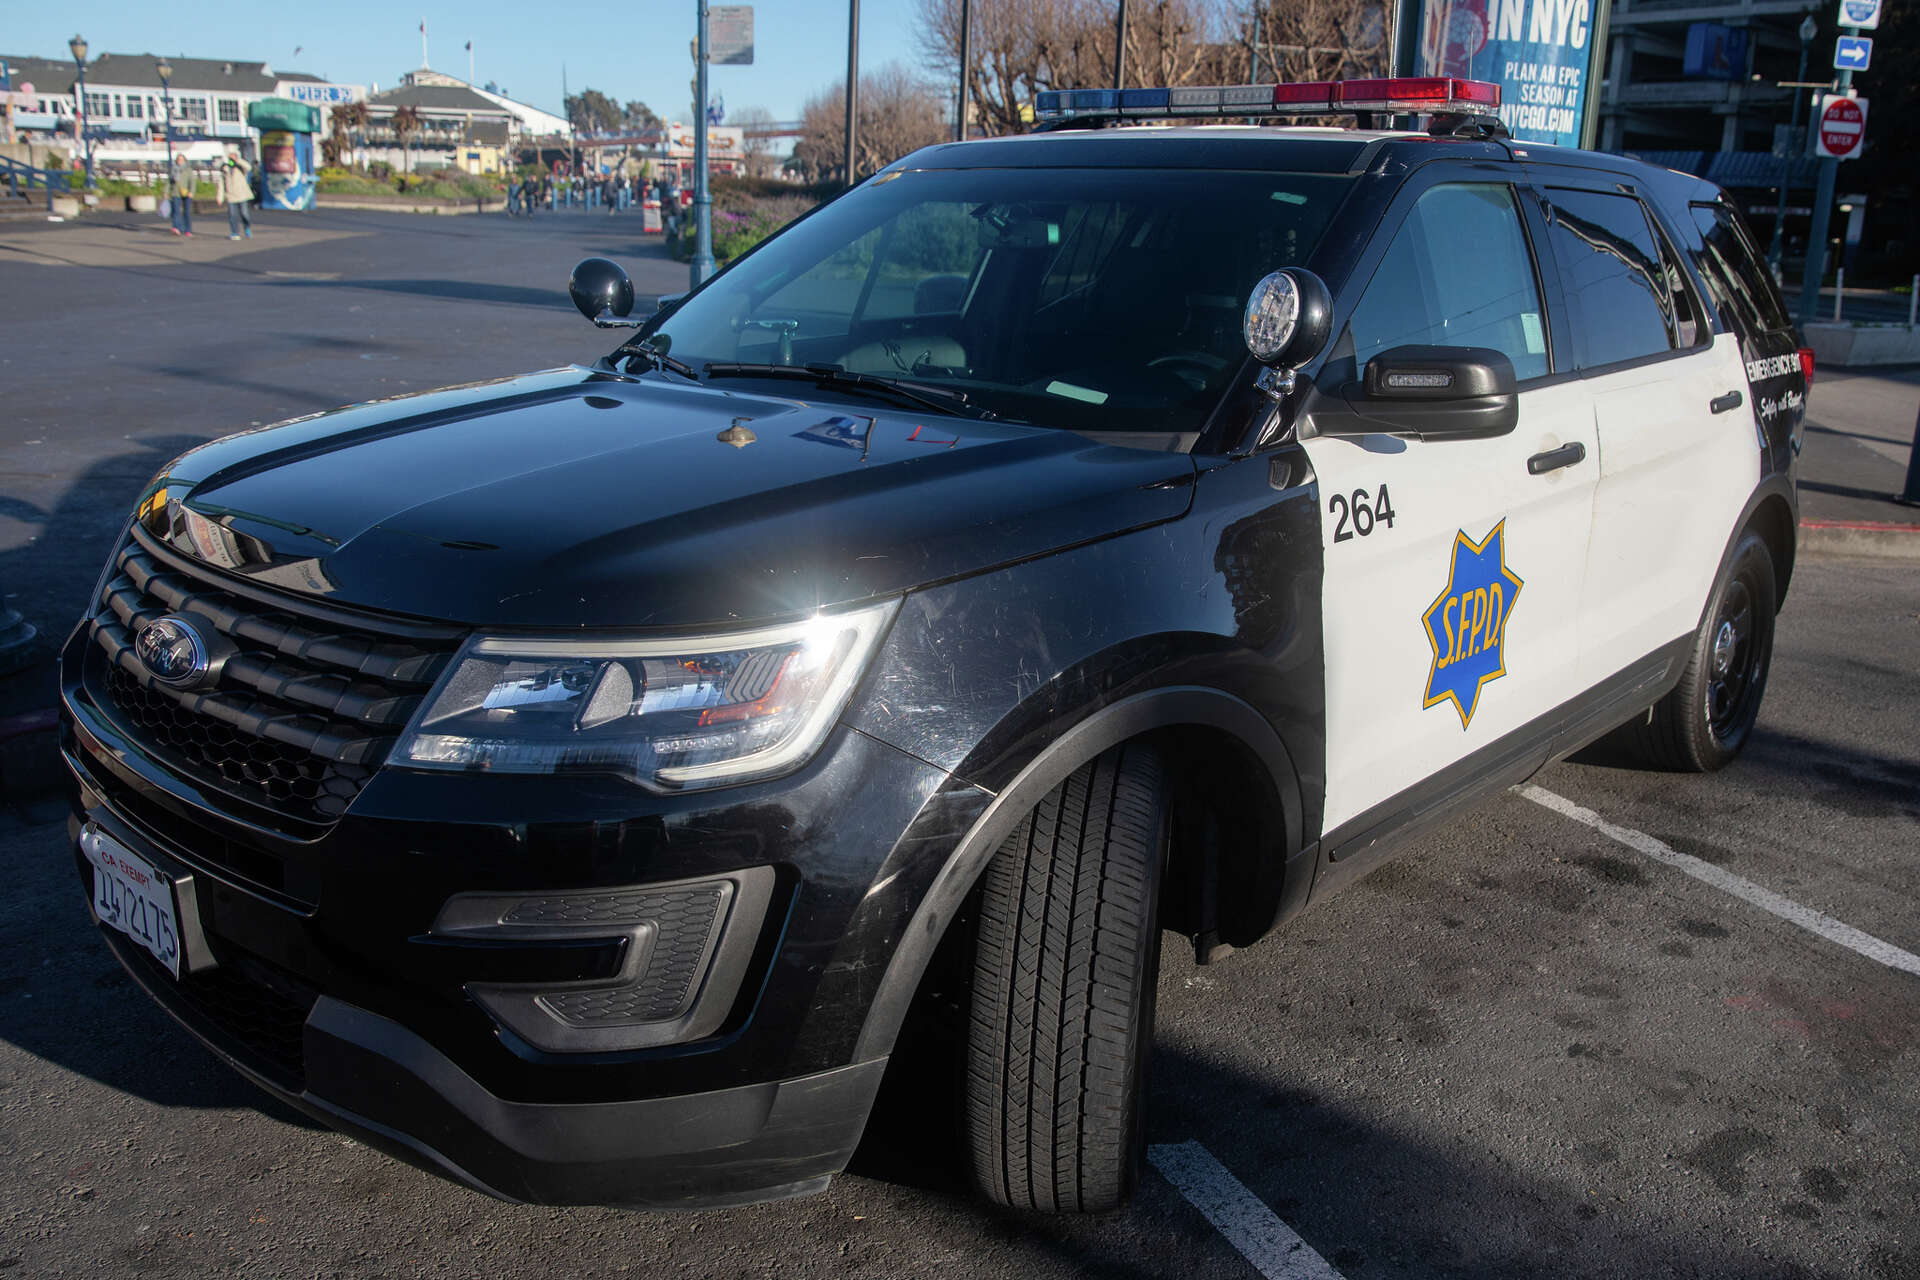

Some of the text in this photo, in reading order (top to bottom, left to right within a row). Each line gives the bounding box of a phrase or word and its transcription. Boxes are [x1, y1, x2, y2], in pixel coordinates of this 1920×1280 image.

[1487, 0, 1589, 49] IN NYC
[1504, 61, 1581, 87] PLAN AN EPIC
[1520, 83, 1579, 107] SEASON AT
[1500, 103, 1576, 134] NYCGO.COM
[1828, 107, 1860, 121] DO NOT
[1827, 134, 1853, 146] ENTER
[1746, 354, 1791, 382] EMERGENCY
[1329, 483, 1396, 544] 264
[1437, 582, 1503, 669] S.F.P.D.
[101, 851, 151, 890] CA EXEMPT
[96, 865, 177, 959] 1472175
